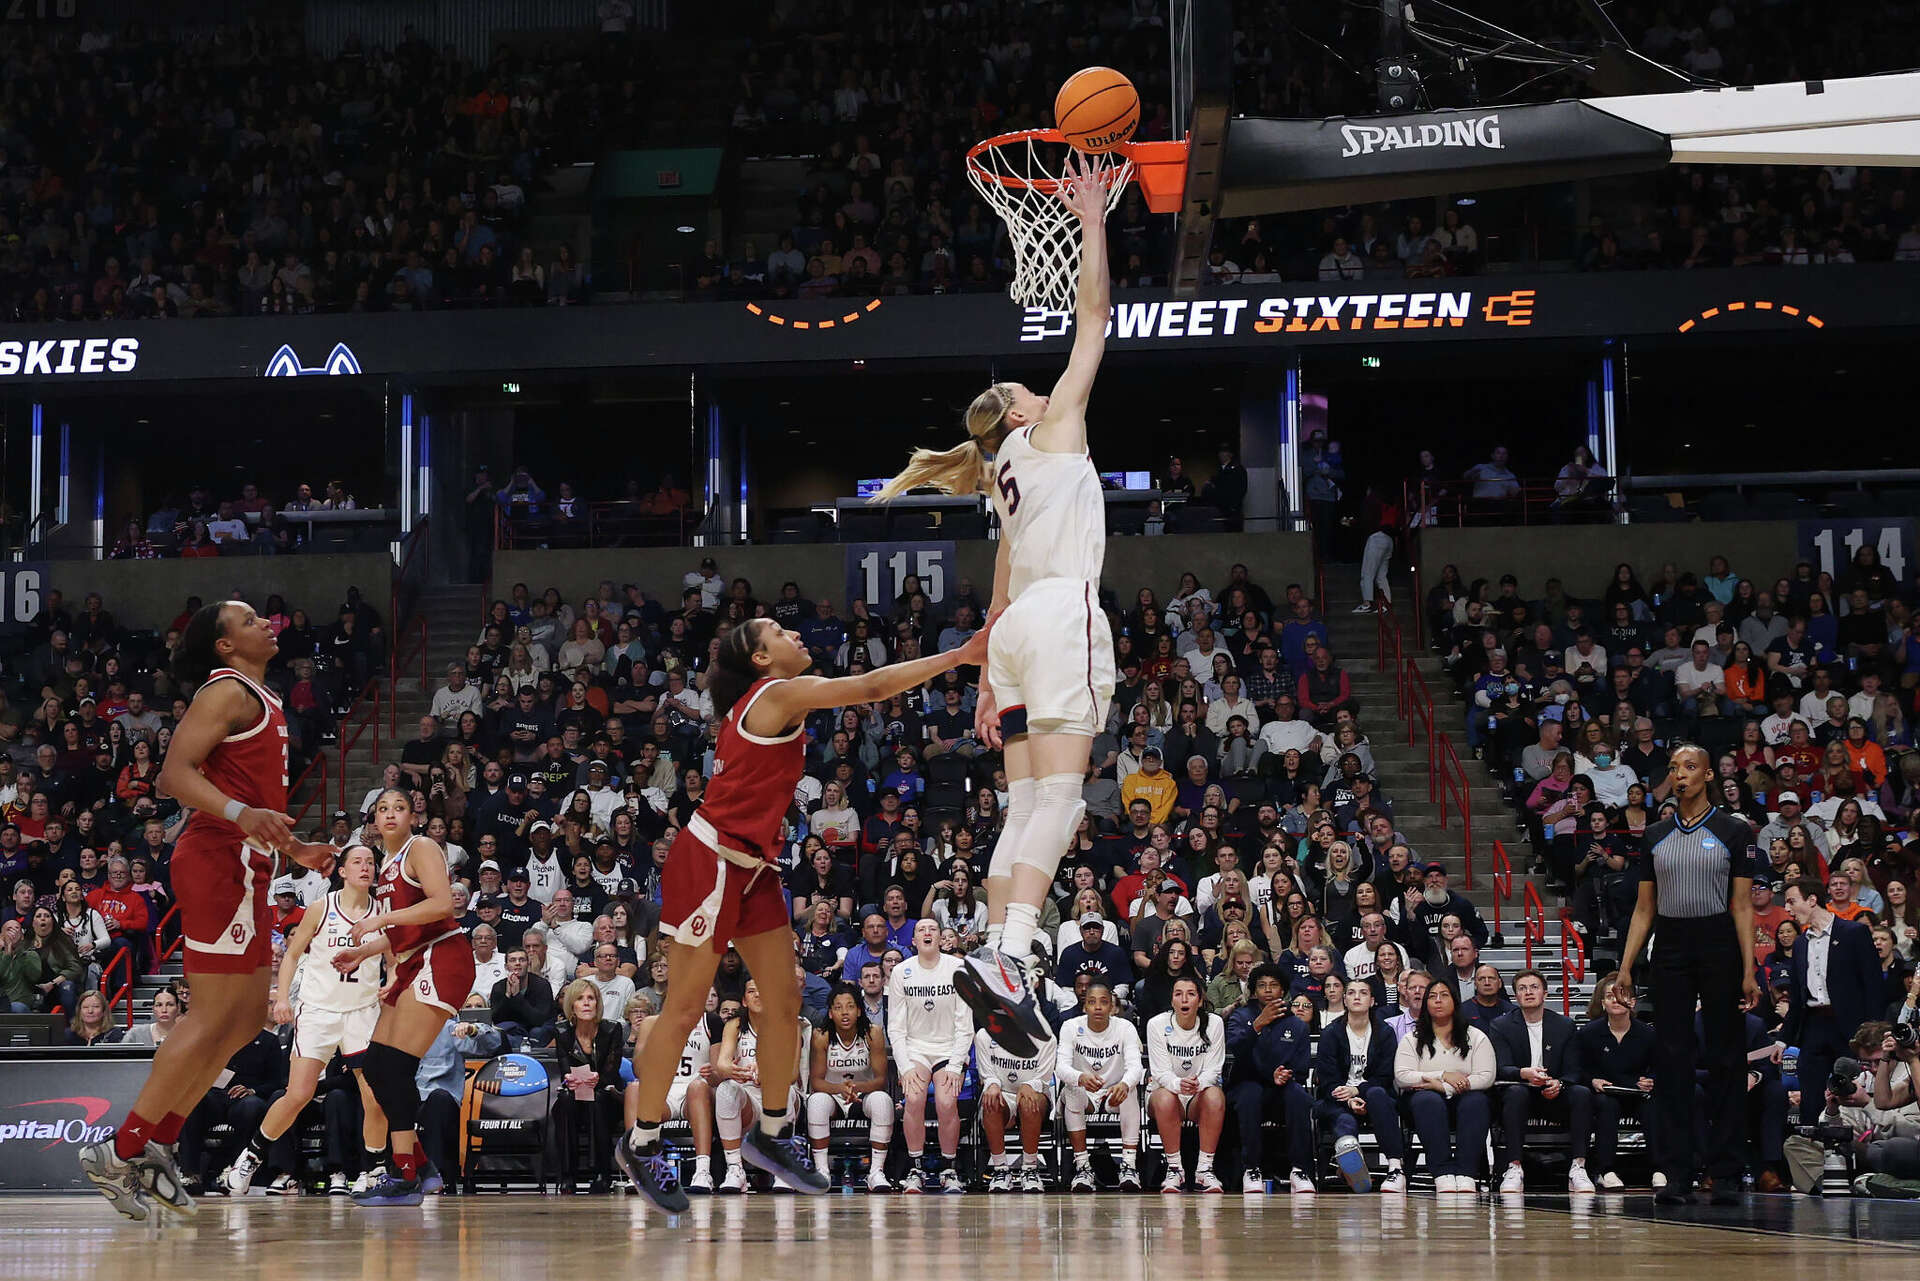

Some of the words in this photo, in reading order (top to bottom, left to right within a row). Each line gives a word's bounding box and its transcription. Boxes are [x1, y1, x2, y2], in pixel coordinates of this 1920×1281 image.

[1084, 118, 1137, 148] Wilson
[1341, 114, 1501, 158] SPALDING
[1104, 299, 1248, 339] WEET
[1253, 291, 1472, 334] SIXTEEN
[0, 337, 140, 376] SKIES
[997, 459, 1021, 517] 5
[861, 550, 944, 605] 115
[497, 812, 525, 826] UCON
[532, 865, 555, 873] UCONN
[537, 874, 549, 887] 21
[501, 912, 530, 923] UCONN
[691, 915, 707, 937] OU
[231, 922, 246, 945] OU
[1075, 959, 1109, 977] CONN
[1353, 962, 1376, 977] UCO
[420, 979, 432, 996] OU
[903, 985, 936, 997] NOTHING
[1076, 1042, 1104, 1059] NOTHING
[828, 1057, 869, 1068] UCONN
[480, 1119, 500, 1130] FOUR
[500, 1119, 509, 1130] IT
[680, 1120, 688, 1129] IT
[831, 1119, 847, 1129] OUR
[847, 1119, 855, 1129] IT
[855, 1119, 869, 1129] ALL
[1085, 1113, 1099, 1122] OUR
[1100, 1113, 1108, 1122] IT
[0, 1118, 65, 1143] pital
